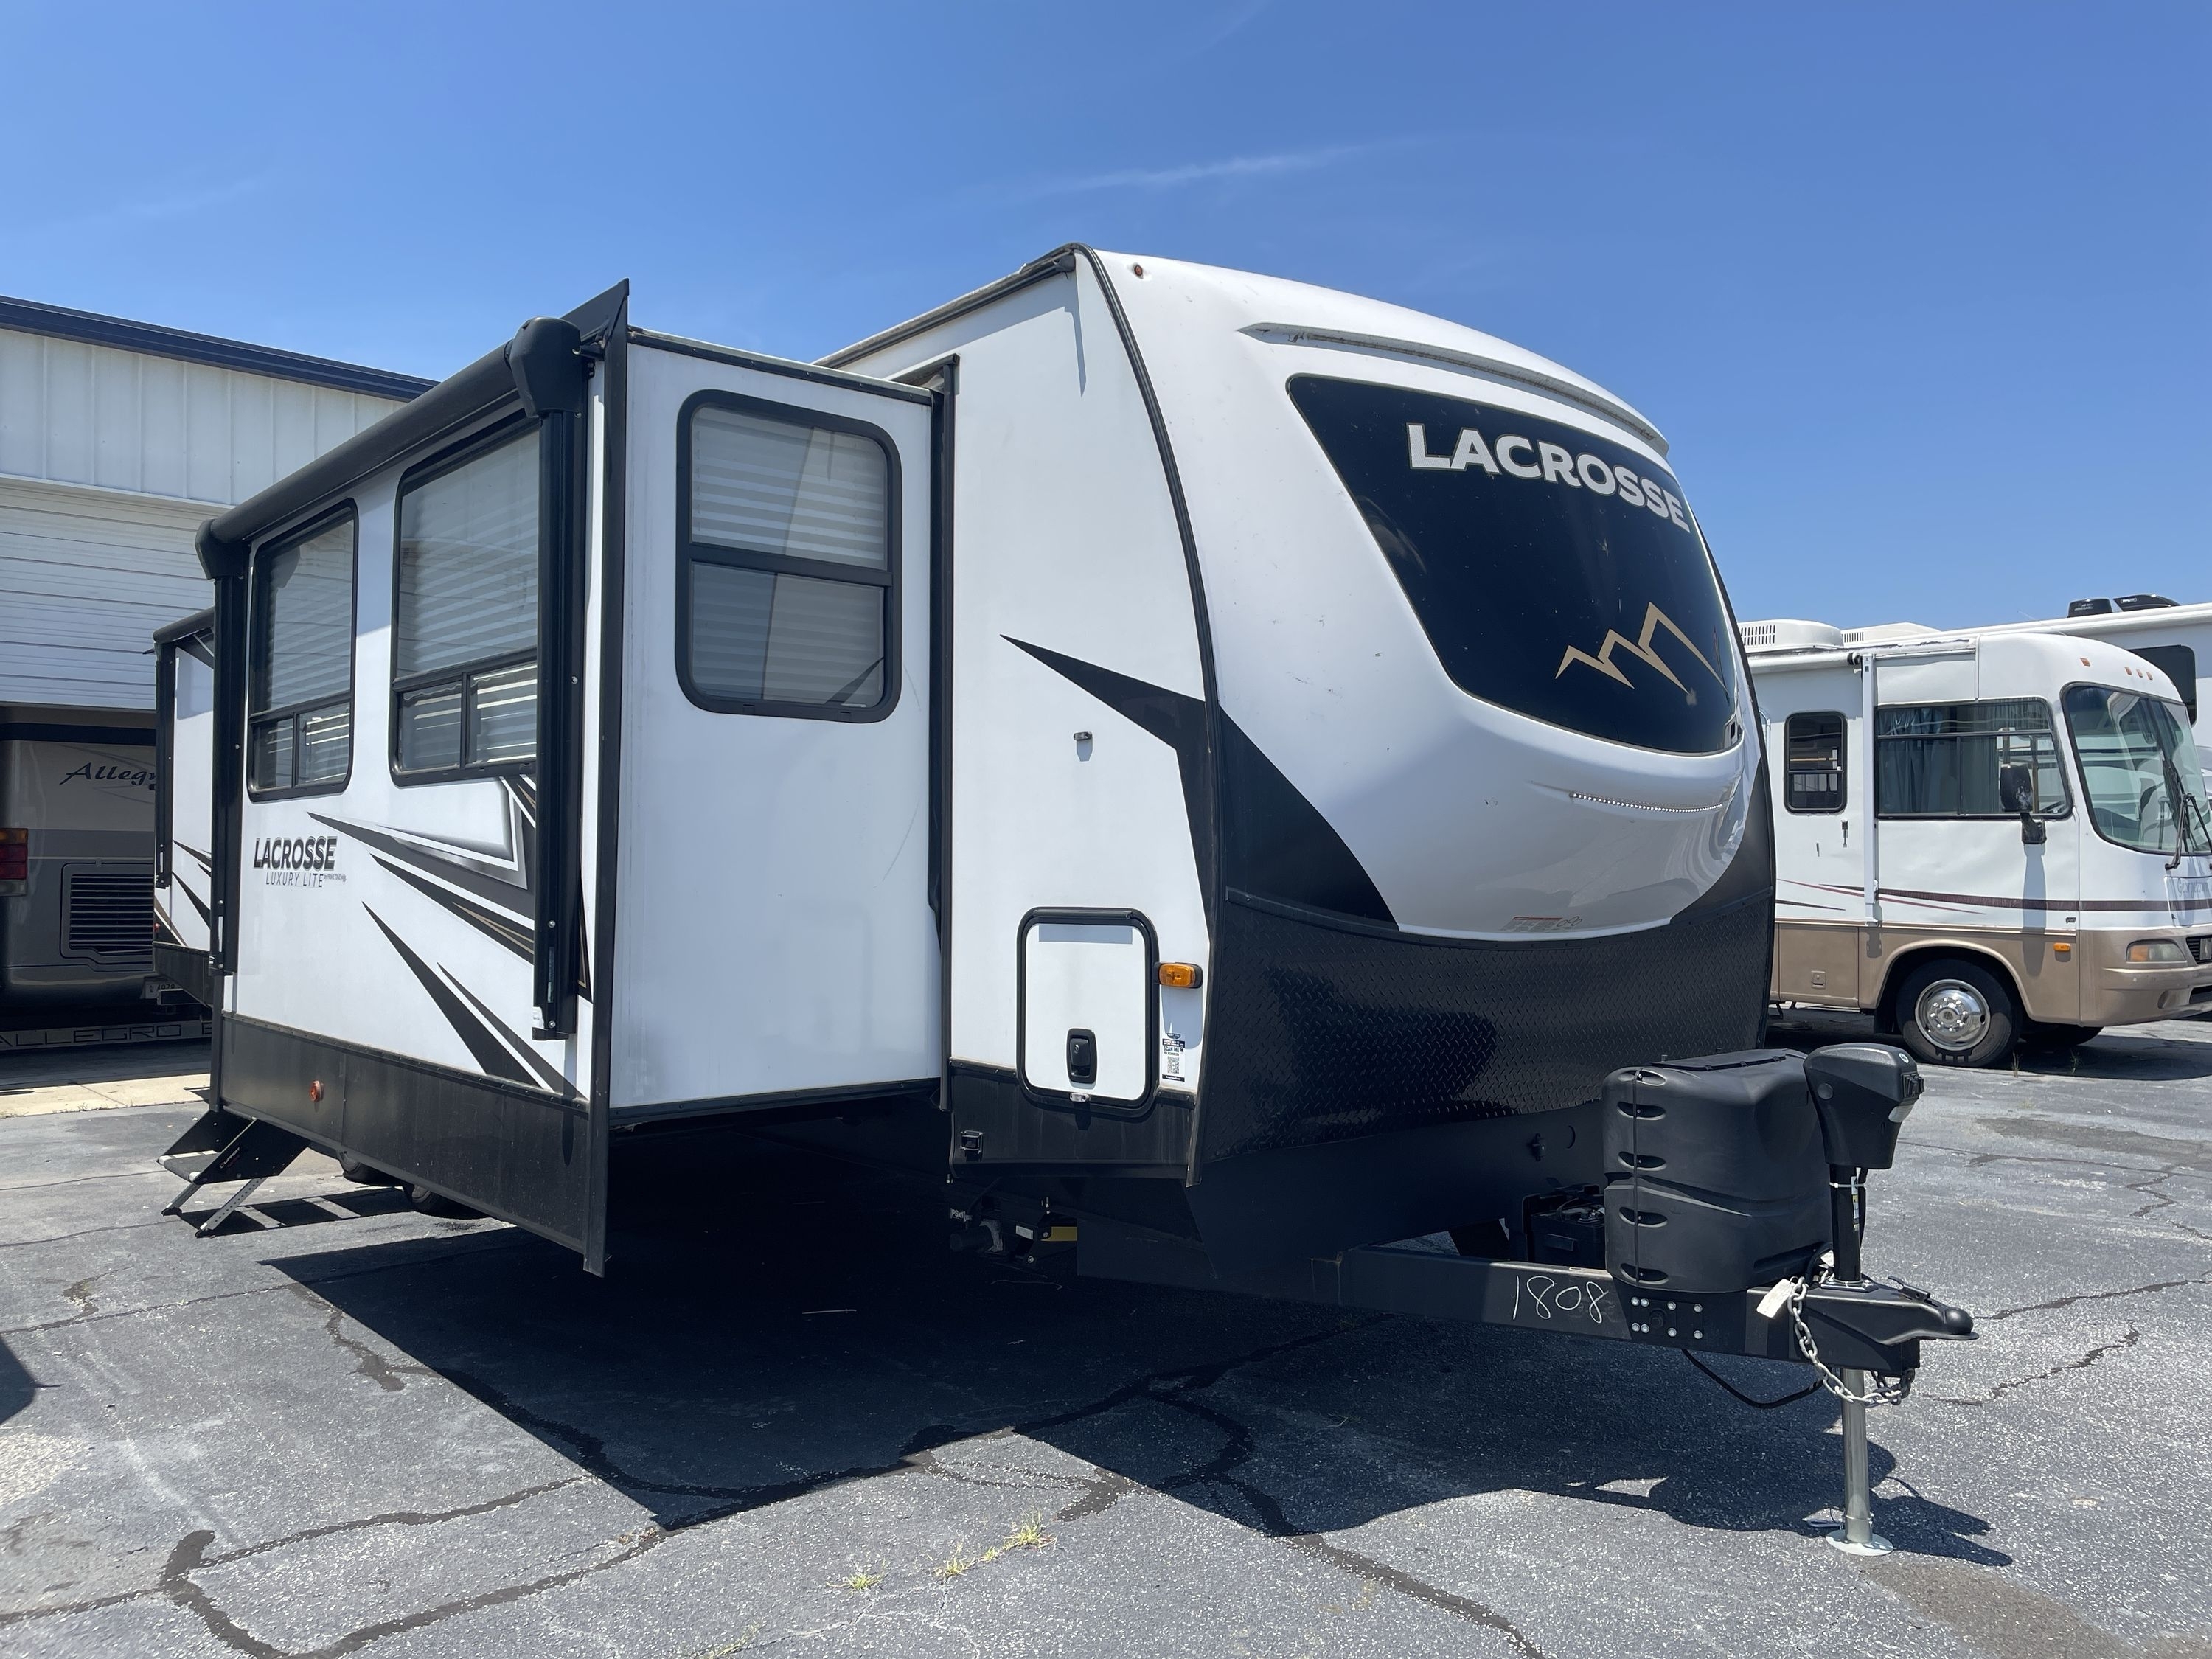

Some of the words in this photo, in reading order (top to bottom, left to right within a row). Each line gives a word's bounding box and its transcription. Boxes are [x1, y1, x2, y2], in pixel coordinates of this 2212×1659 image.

[1406, 422, 1691, 532] LACROSSE
[253, 835, 338, 871] LACROSSE
[265, 872, 300, 886] LUXURY
[303, 872, 324, 888] LITE
[1513, 1275, 1609, 1324] 1808
